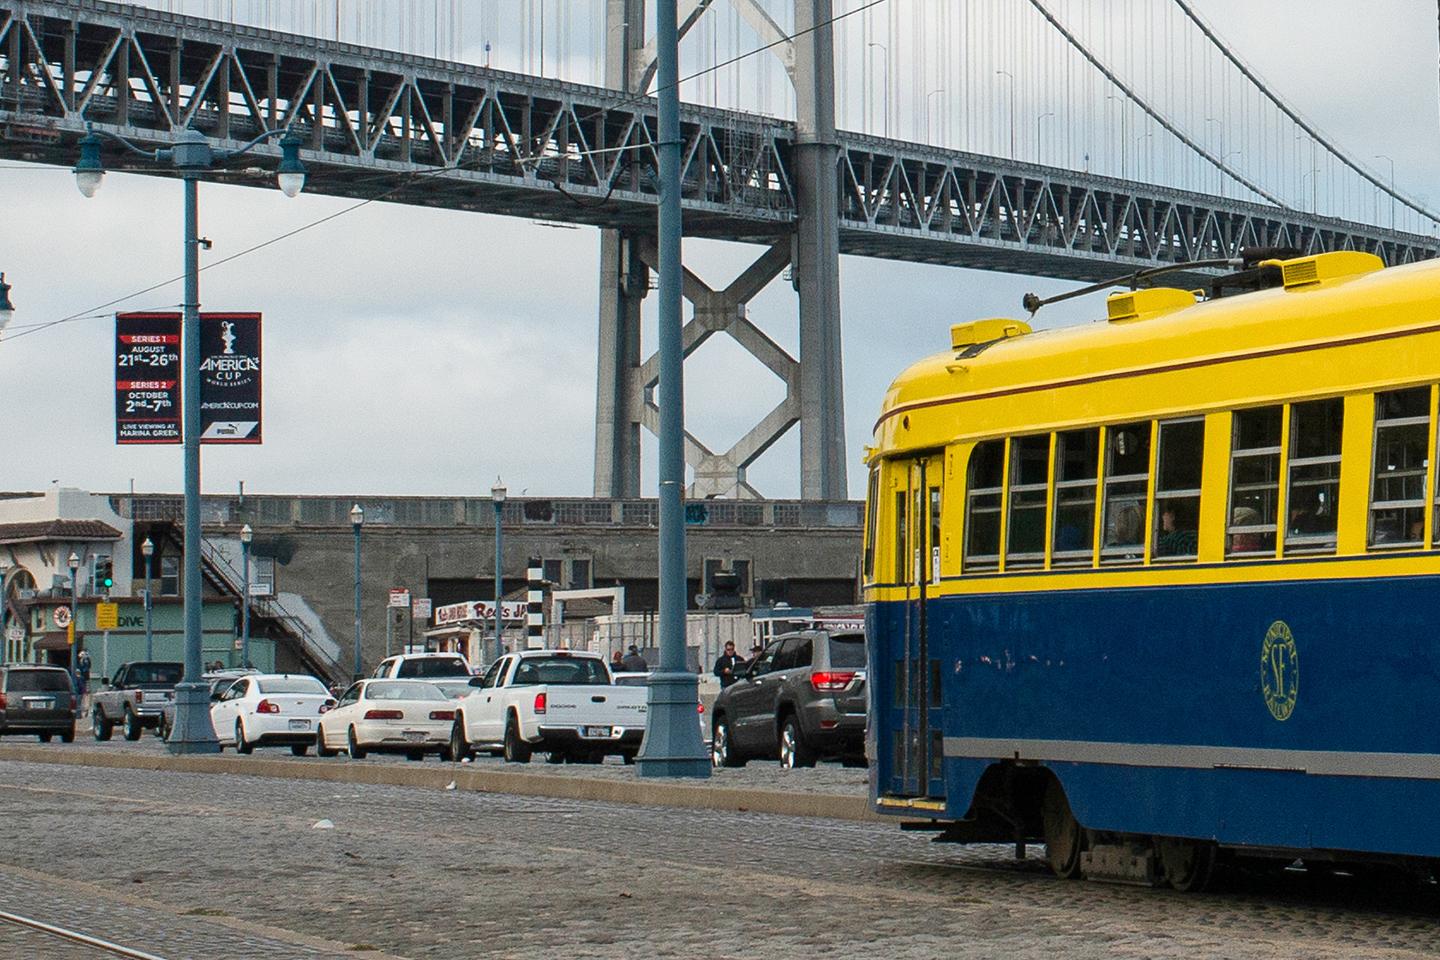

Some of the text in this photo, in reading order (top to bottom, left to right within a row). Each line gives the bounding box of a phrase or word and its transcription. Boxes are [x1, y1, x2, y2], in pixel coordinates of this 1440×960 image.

[131, 335, 166, 343] SERIES 1
[216, 371, 242, 380] CUP
[130, 381, 167, 389] SERIES 2
[206, 377, 252, 387] WORLD SERIES
